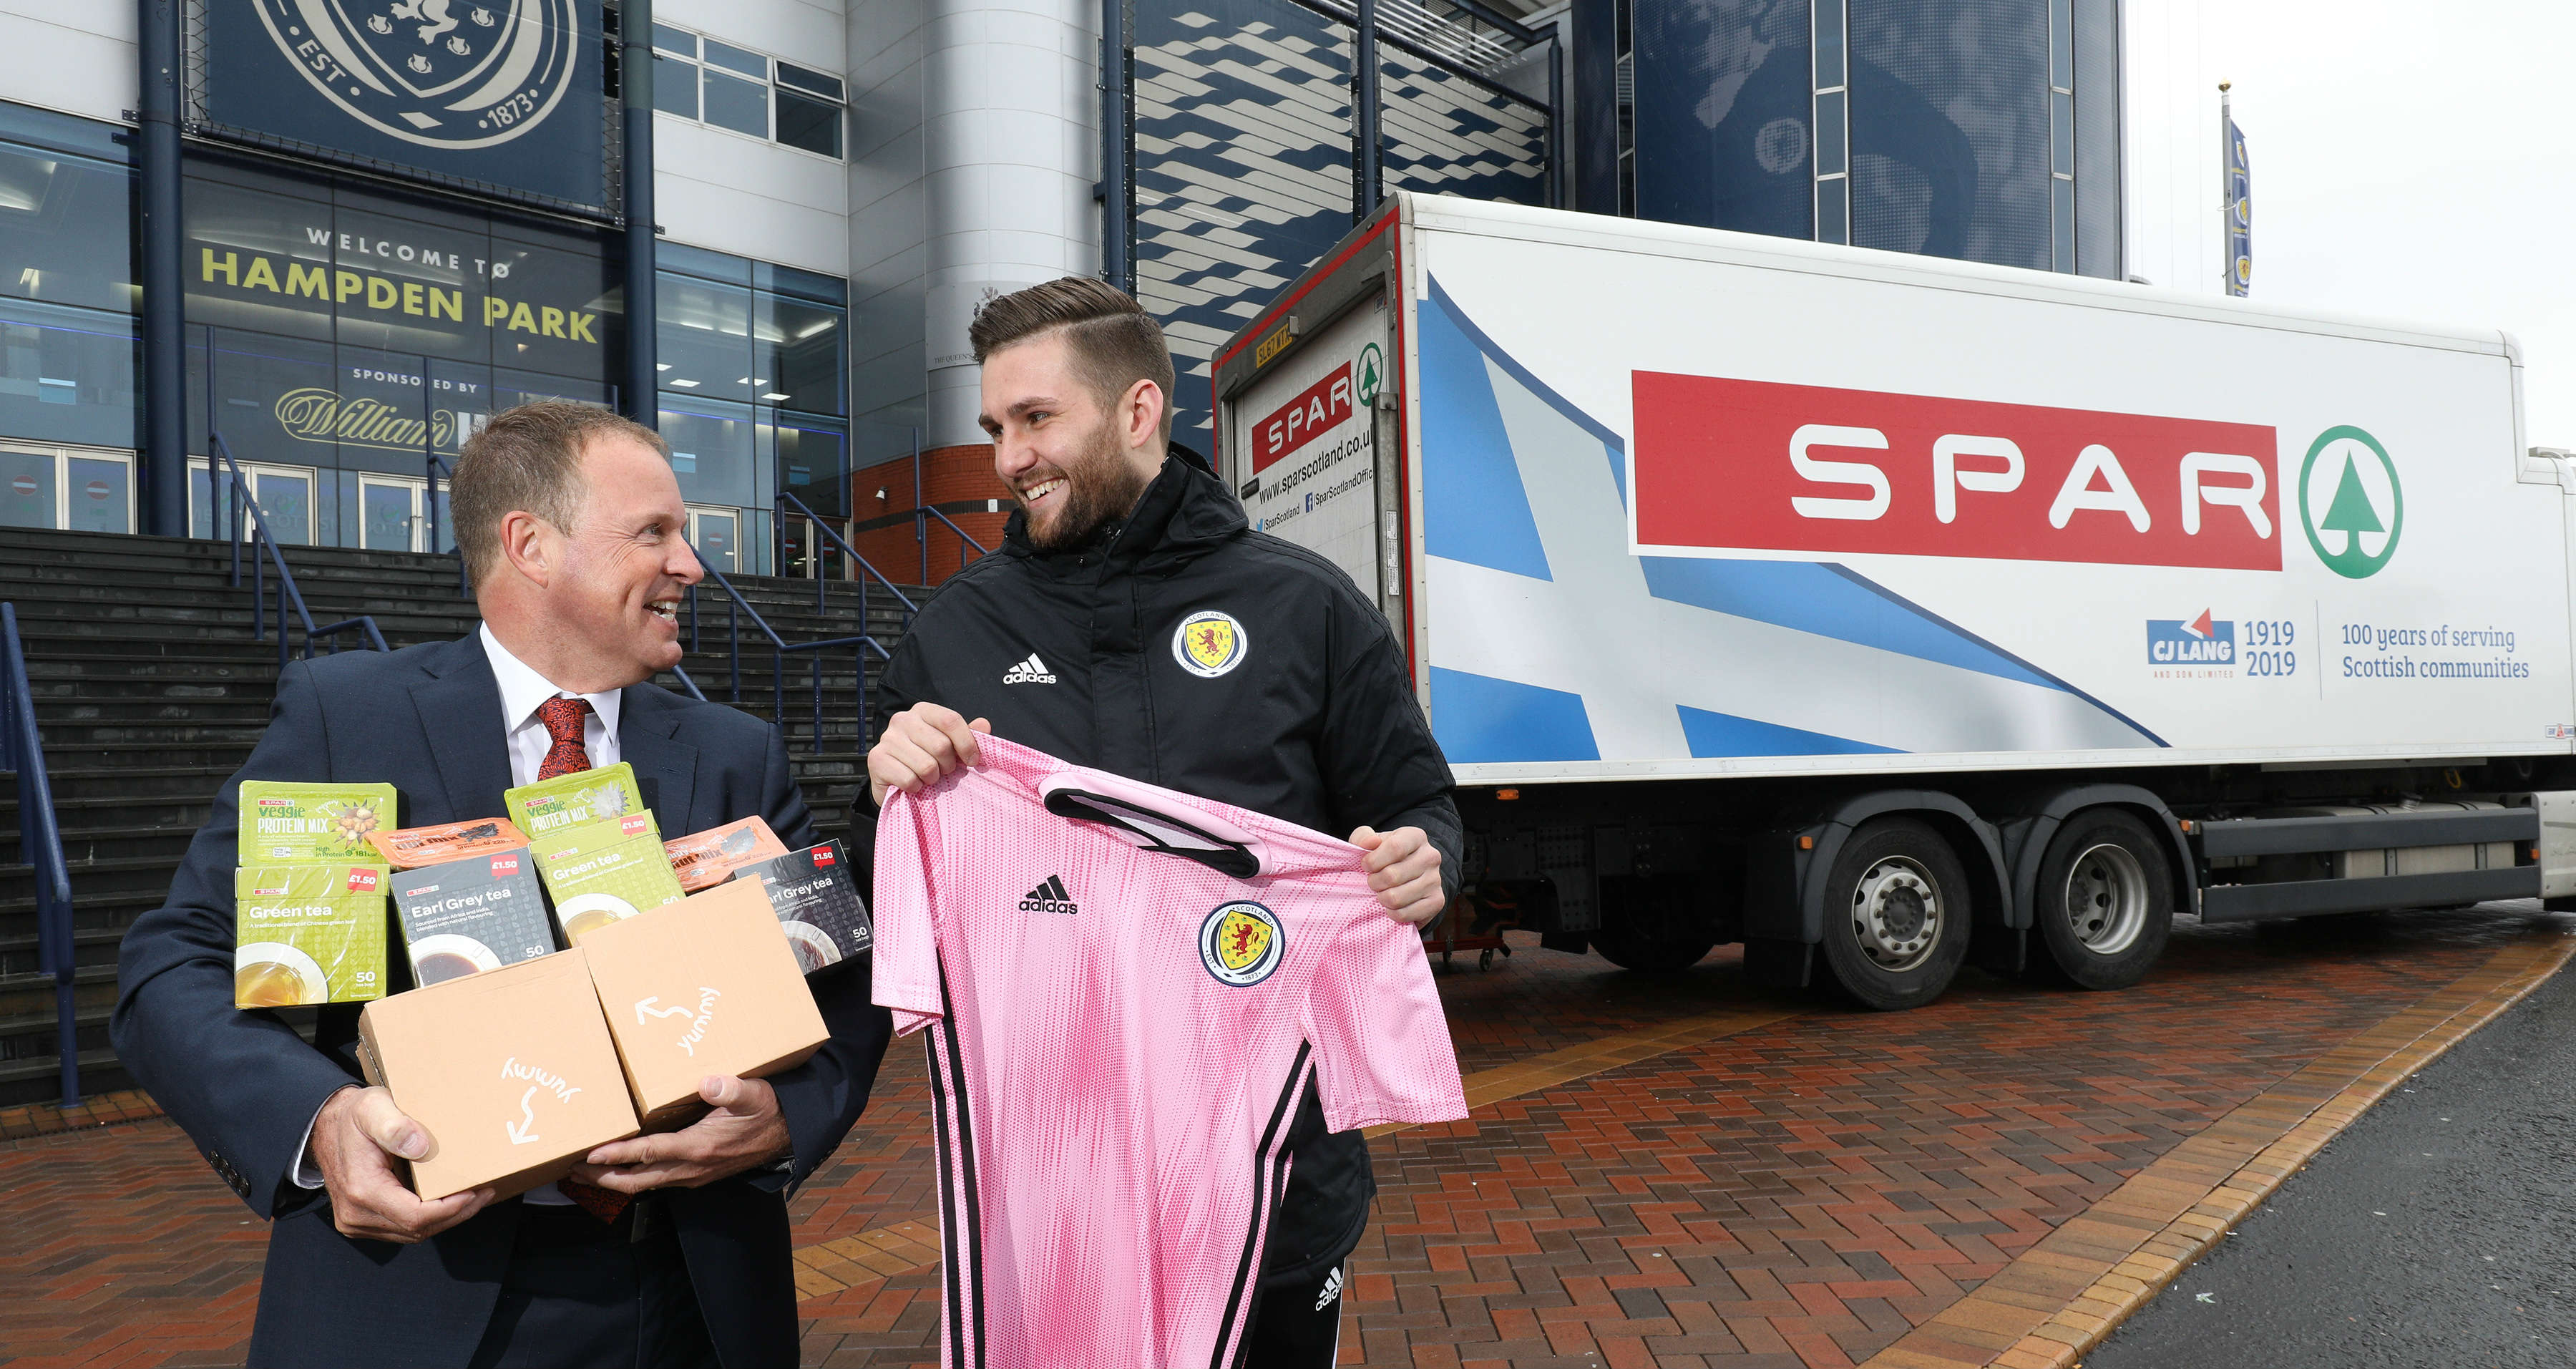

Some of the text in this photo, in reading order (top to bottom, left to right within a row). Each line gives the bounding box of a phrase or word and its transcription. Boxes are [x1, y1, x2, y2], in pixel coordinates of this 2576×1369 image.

[297, 39, 346, 82] EST
[487, 92, 534, 128] 1873
[306, 227, 510, 278] WELCOME TO
[202, 248, 597, 344] HAMPDEN PARK
[934, 355, 945, 364] THE
[353, 369, 477, 394] SPONSOED BY
[275, 387, 455, 448] William
[1269, 376, 1350, 454] SPAR
[1789, 424, 2273, 540] SPAR
[1189, 612, 1225, 622] SCOTLAND
[2245, 620, 2294, 645] 1919
[2342, 624, 2514, 653] 100 years of serving
[2153, 640, 2232, 661] CJ LANG
[2246, 651, 2296, 676] 2019
[2343, 656, 2529, 678] Scottish communities
[1002, 671, 1057, 685] adidas
[258, 807, 306, 818] veggie
[527, 800, 565, 816] veggie
[258, 818, 328, 834] PROTEIN MIX
[530, 809, 571, 832] PROTEIN
[572, 806, 590, 822] MIX
[622, 819, 645, 829] £1.50
[492, 861, 517, 869] £1.50
[553, 861, 597, 880] Green
[597, 853, 621, 866] tea
[813, 852, 833, 861] £1.50
[348, 874, 376, 885] £1.50
[784, 882, 811, 899] Grey
[813, 877, 834, 890] tea
[411, 889, 512, 918] Earl Grey tea
[663, 896, 679, 905] 50
[1019, 900, 1078, 915] adidas
[250, 905, 333, 919] Green tea
[1236, 906, 1272, 923] SCOTLAND
[852, 926, 868, 938] 50
[526, 945, 545, 958] 50
[1206, 954, 1214, 964] EST
[356, 971, 376, 983] 50
[676, 987, 721, 1057] yummy
[501, 1057, 582, 1104] yummy
